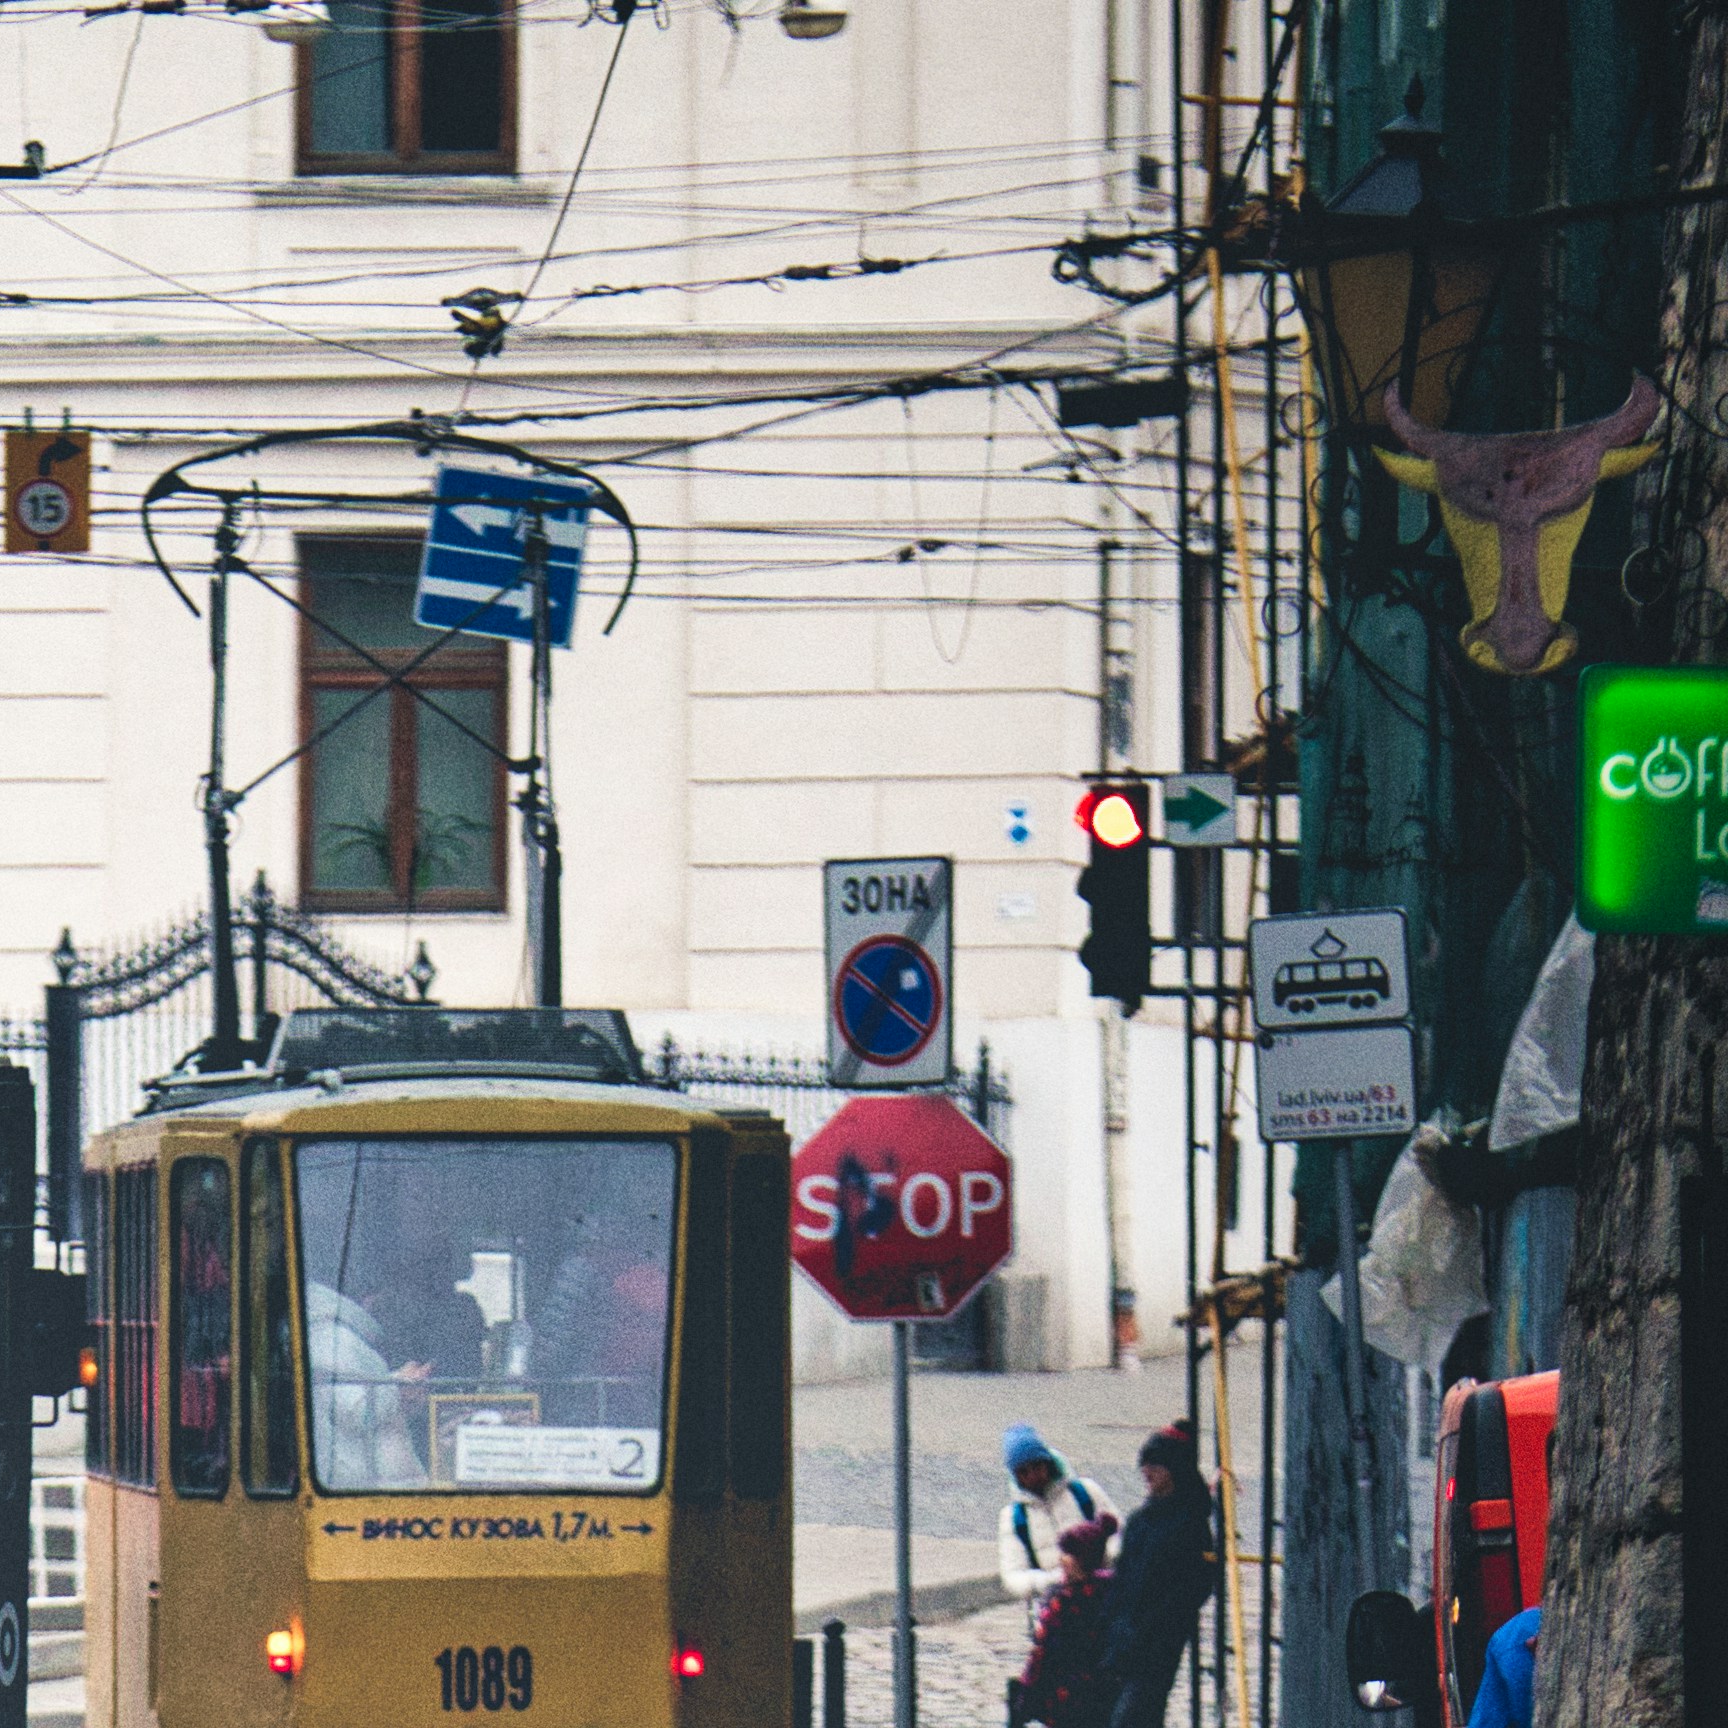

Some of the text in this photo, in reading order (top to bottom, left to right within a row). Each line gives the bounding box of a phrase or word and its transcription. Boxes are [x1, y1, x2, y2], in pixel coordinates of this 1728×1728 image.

[28, 493, 60, 522] 15
[841, 874, 932, 915] ЗОНА
[1362, 1104, 1407, 1122] 2214
[609, 1437, 645, 1479] 2
[362, 1517, 444, 1541] ВИНОС
[449, 1517, 544, 1540] КУЗОВА
[434, 1645, 534, 1713] 1089
